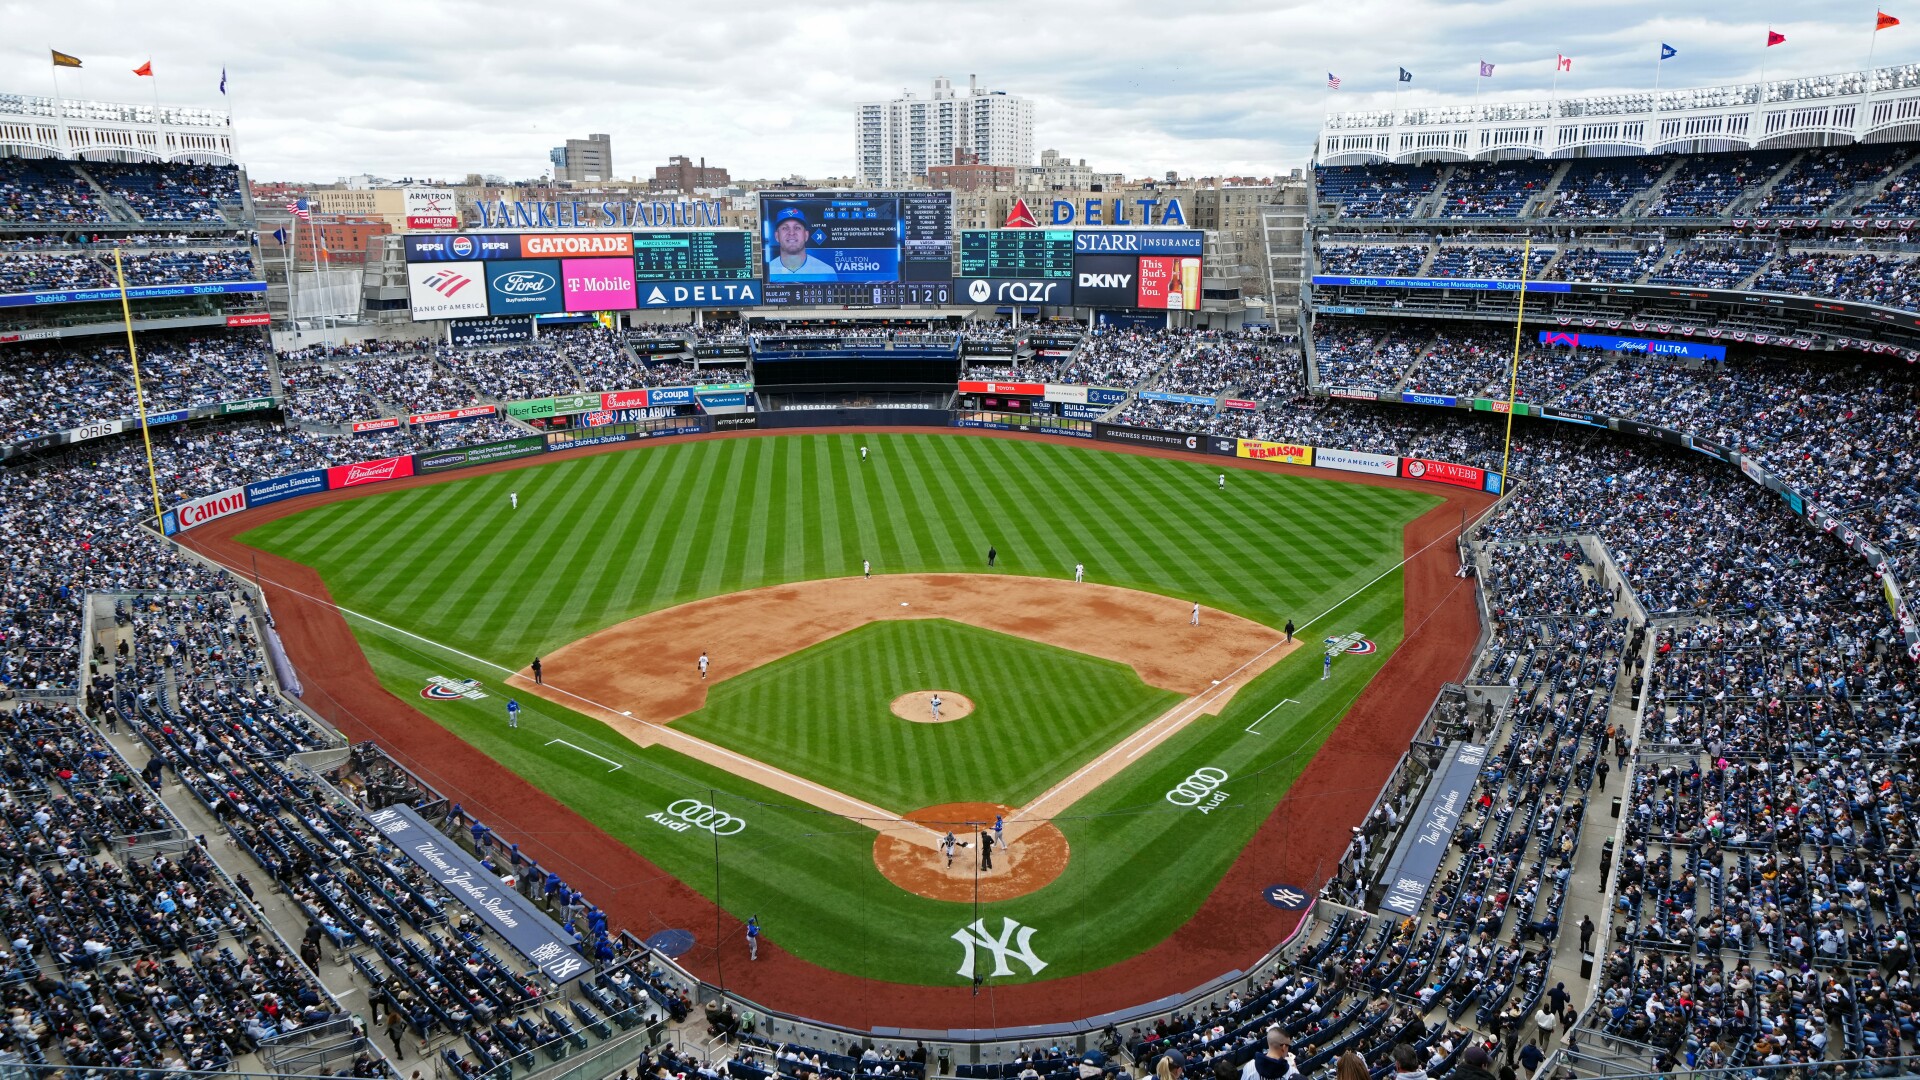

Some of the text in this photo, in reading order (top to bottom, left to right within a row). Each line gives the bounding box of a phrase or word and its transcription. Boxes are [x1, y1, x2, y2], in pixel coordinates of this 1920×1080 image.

[475, 200, 722, 229] YANKEE STADIUM
[1053, 198, 1189, 226] DELTA
[414, 217, 453, 225] ARMITRON
[416, 243, 444, 252] PEPSI
[482, 242, 509, 250] PEPSI
[527, 237, 628, 254] GATORADE
[1076, 234, 1200, 250] STARR INSURANCE
[835, 262, 880, 271] VARSHO
[1141, 259, 1163, 268] This
[1142, 269, 1167, 277] Bud's
[504, 274, 545, 292] Ford
[584, 277, 631, 292] Mobile
[1079, 273, 1132, 288] DKNY
[1141, 278, 1157, 286] For
[1350, 278, 1378, 286] StubHub
[35, 285, 224, 303] StubHub Official Yankee Ticket Marketplace StubHub
[674, 285, 755, 301] DELTA
[924, 290, 932, 302] 2
[938, 290, 947, 302] 0
[998, 282, 1057, 301] razr
[1141, 287, 1161, 296] You.
[240, 316, 270, 325] Budweiser
[1655, 343, 1689, 354] ULTRA
[663, 390, 689, 400] coupa
[1329, 388, 1347, 396] Parts
[1347, 388, 1378, 399] Authority
[1413, 395, 1445, 405] StubHub
[226, 398, 271, 413] Poland Spring
[531, 405, 553, 414] Eats
[1064, 403, 1085, 411] BUILD
[147, 413, 178, 424] StubHub
[620, 406, 676, 422] A SUB ABOVE
[1064, 410, 1102, 419] SUBMARIN
[79, 423, 112, 440] ORIS
[1107, 430, 1141, 440] GREATNESS
[1141, 434, 1164, 442] STARTS
[1165, 437, 1182, 445] WITH
[549, 435, 626, 451] StubHub StubHub StubHub
[468, 448, 486, 456] Official
[423, 455, 465, 467] PENNINGTON
[1347, 458, 1380, 467] AMERICA
[351, 466, 394, 480] Budweiser
[1427, 463, 1445, 474] F.W.
[1448, 466, 1477, 480] WEBB
[250, 474, 321, 497] Montefiore Einstein
[179, 492, 244, 527] Canon
[1197, 790, 1230, 815] Audi
[645, 812, 692, 833] Audi
[1418, 829, 1440, 846] New
[443, 870, 488, 900] Yankee
[480, 897, 519, 929] Stadium
[951, 916, 1049, 980] NY
